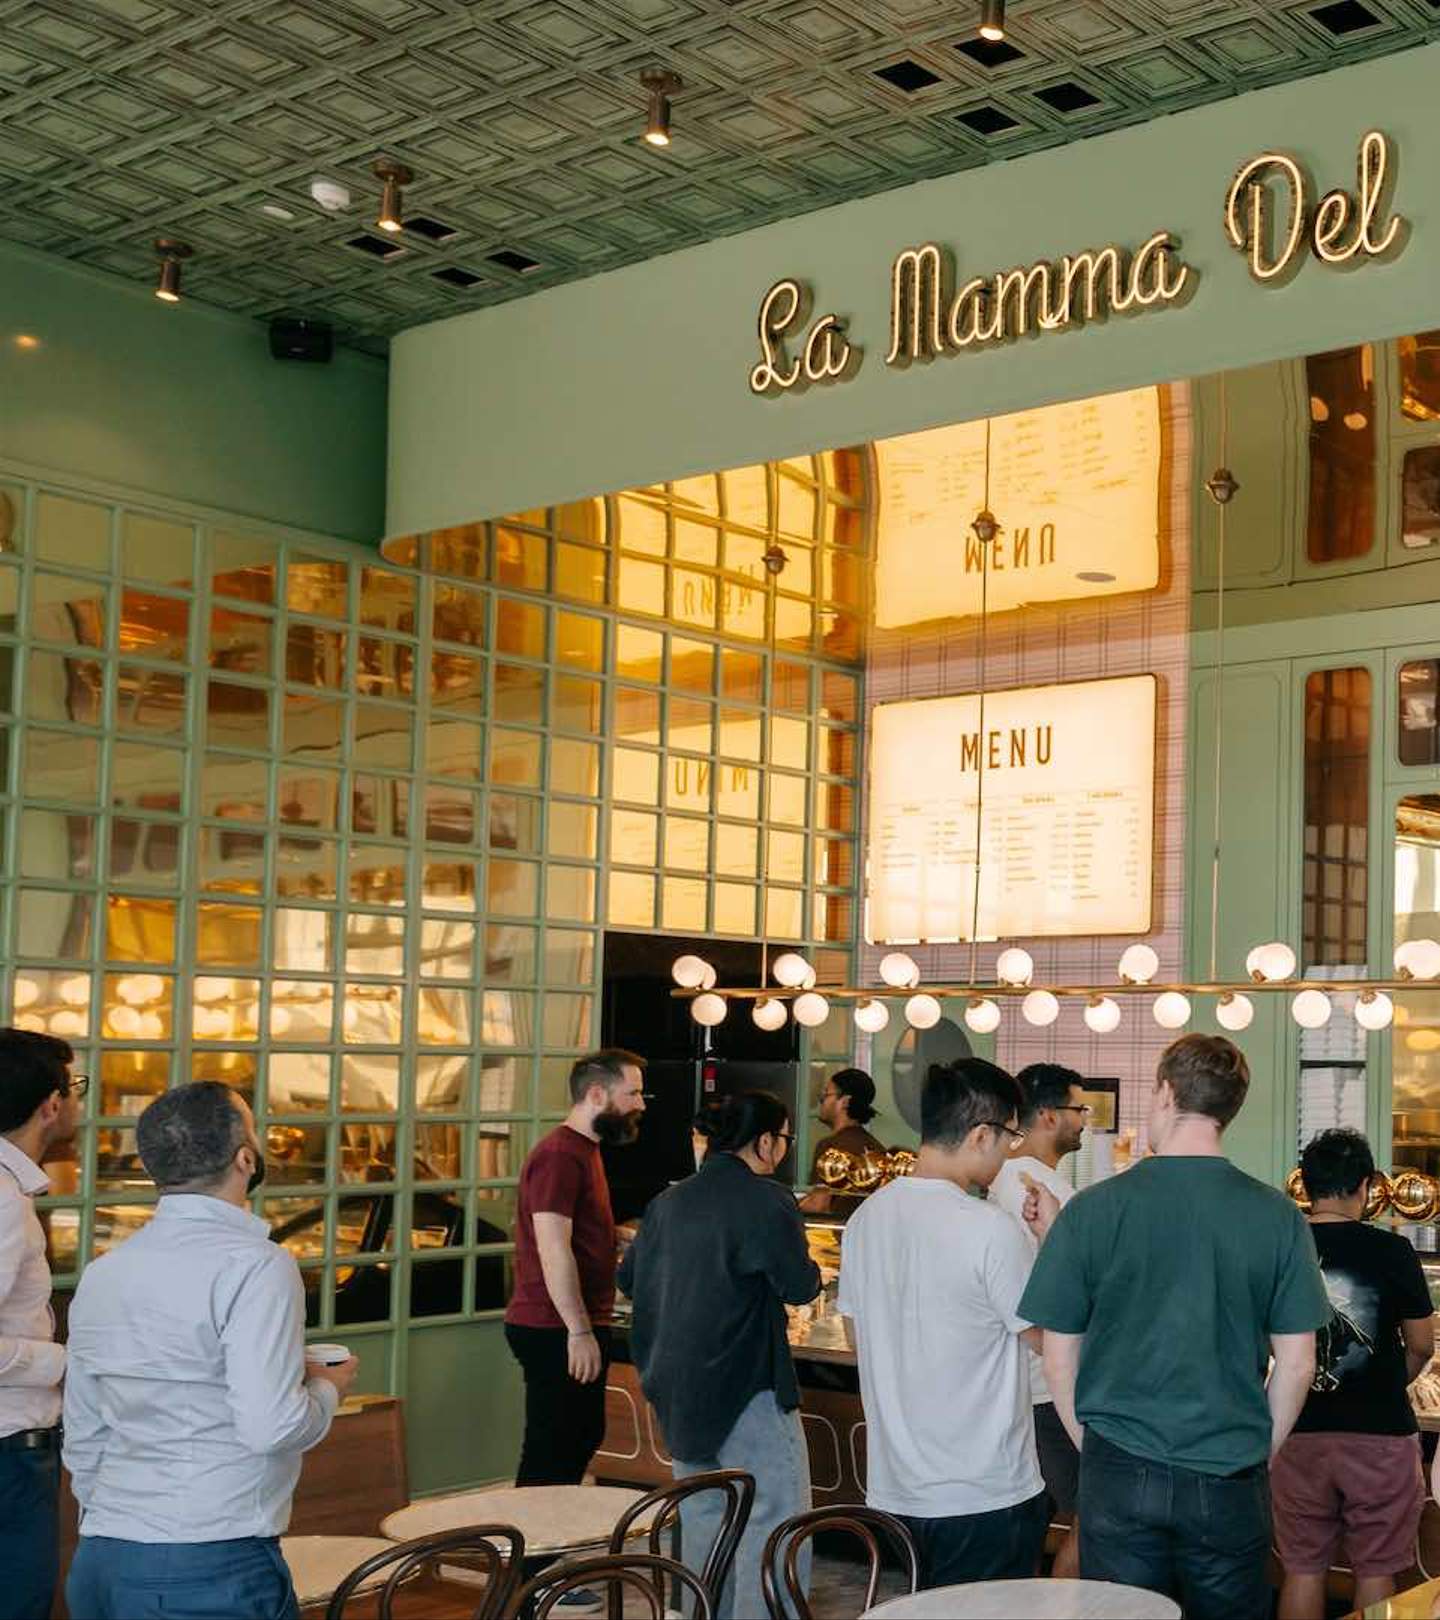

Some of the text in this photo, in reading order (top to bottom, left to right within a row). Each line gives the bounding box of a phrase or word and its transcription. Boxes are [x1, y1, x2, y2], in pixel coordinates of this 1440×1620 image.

[750, 279, 856, 394] La
[885, 231, 1192, 366] Mamma
[1224, 129, 1405, 280] Del
[961, 726, 1051, 772] MENU
